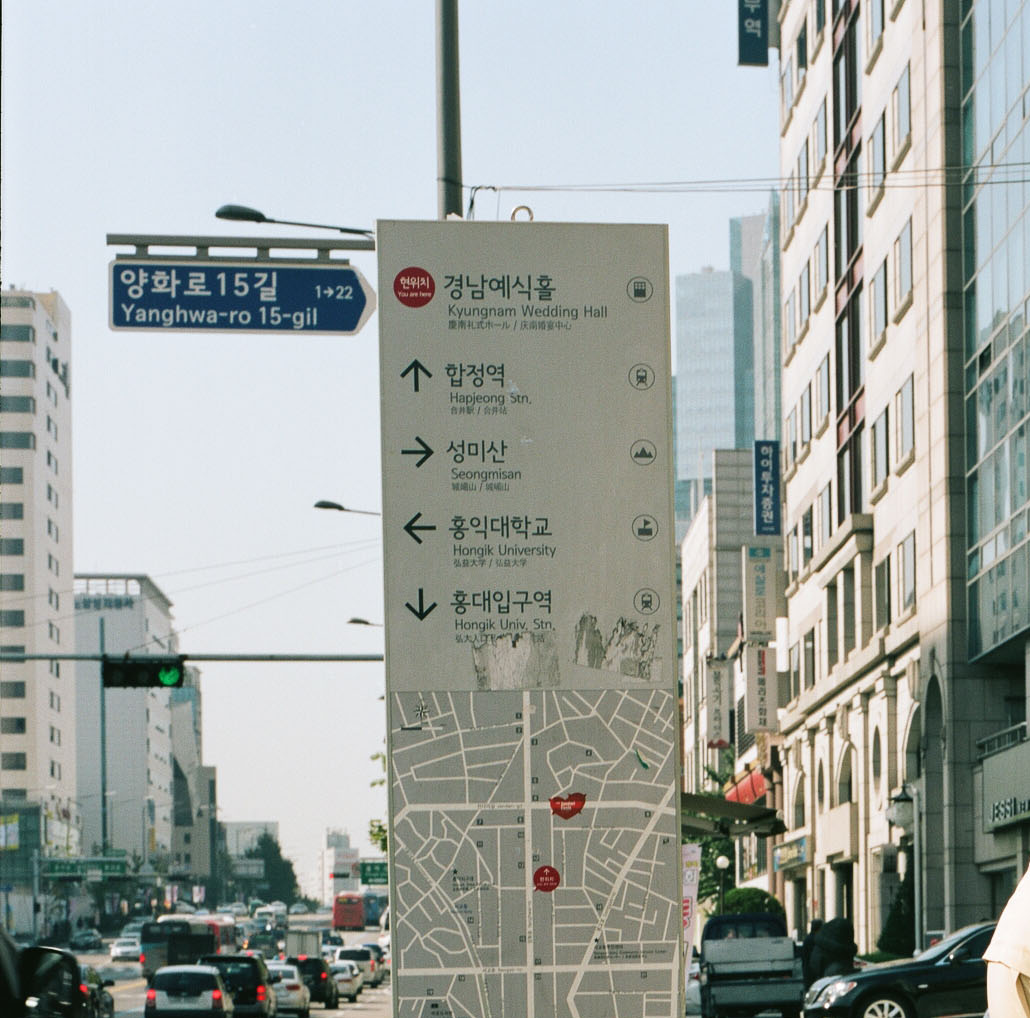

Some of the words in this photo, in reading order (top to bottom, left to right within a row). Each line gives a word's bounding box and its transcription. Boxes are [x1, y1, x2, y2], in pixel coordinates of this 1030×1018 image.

[120, 268, 277, 301] 양화로15길
[400, 276, 430, 289] 현위치
[444, 274, 556, 300] 경남예식홀
[121, 303, 252, 327] Yanghwa-ro
[259, 306, 318, 329] 15-gil
[448, 305, 516, 319] Kyungnam
[522, 305, 579, 319] Wedding
[584, 306, 608, 318] Hall
[445, 363, 505, 388] 합정역
[450, 392, 505, 405] Hapjeong
[510, 392, 532, 405] Stn.
[447, 440, 508, 464] 성미산
[451, 468, 522, 482] Seongmisan
[449, 515, 552, 540] 홍익대학교
[453, 544, 494, 558] Hongik
[498, 544, 556, 558] University
[451, 590, 551, 614] 홍대입구역
[455, 619, 495, 632] Hongik
[500, 619, 528, 630] Univ.
[533, 618, 556, 631] Stn.
